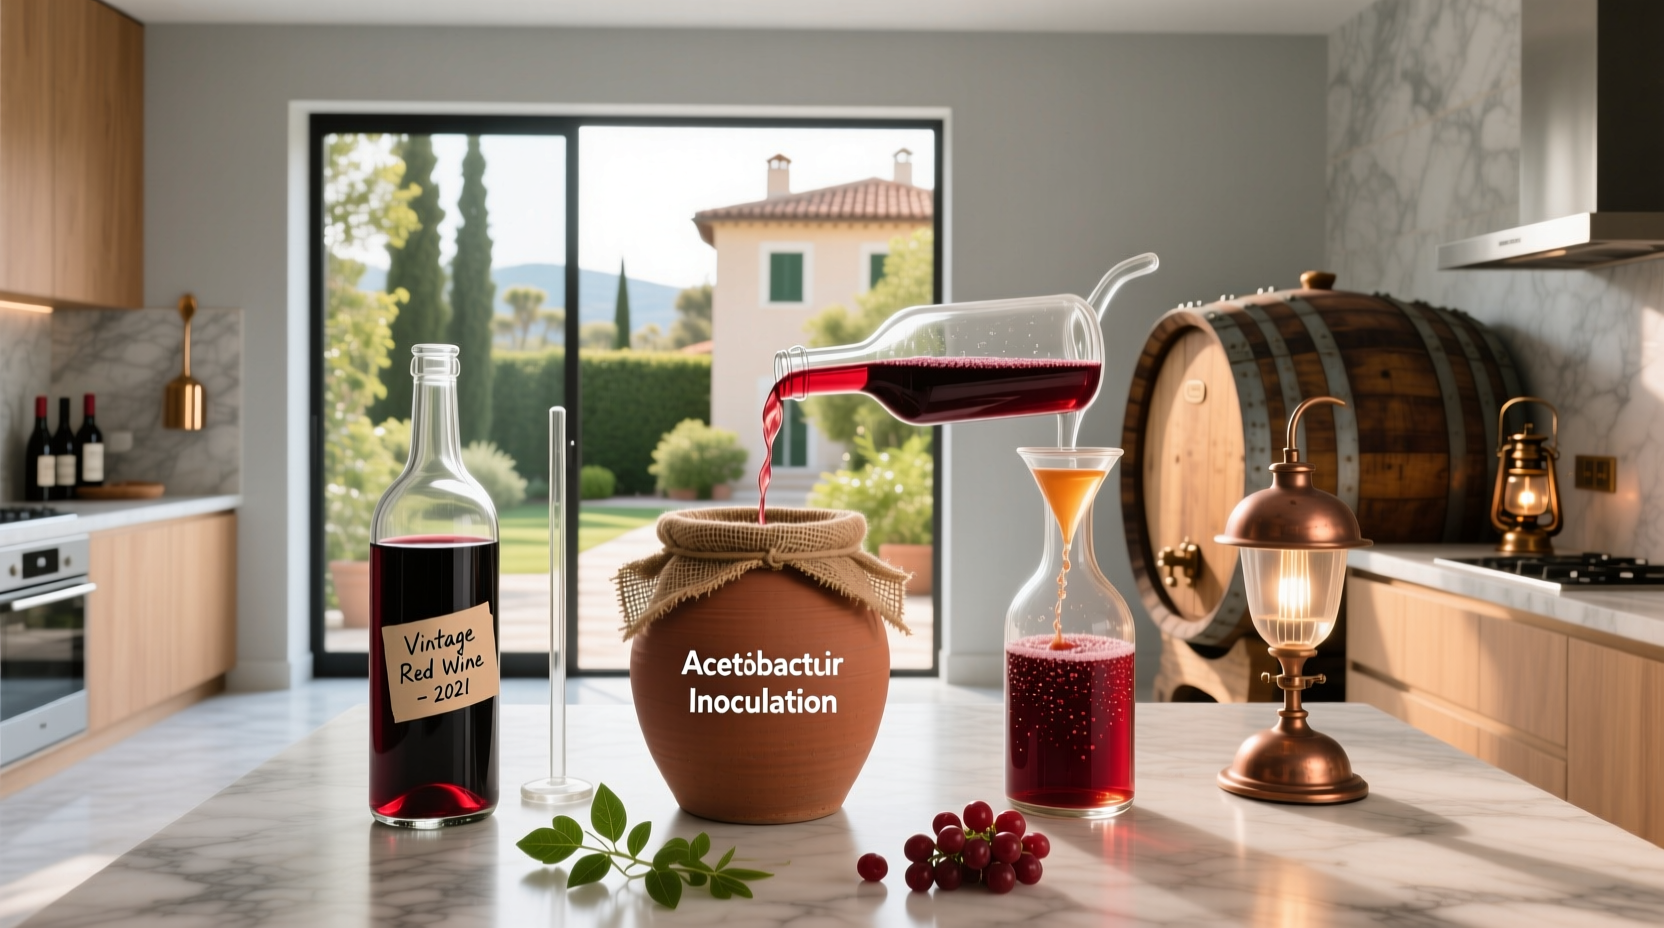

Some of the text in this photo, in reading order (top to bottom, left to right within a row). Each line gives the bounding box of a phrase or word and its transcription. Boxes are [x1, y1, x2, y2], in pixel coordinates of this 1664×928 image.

[403, 628, 475, 656] Vintage
[400, 654, 484, 684] Red Wine
[434, 677, 470, 703] 2021
[689, 687, 837, 714] Inoculation
